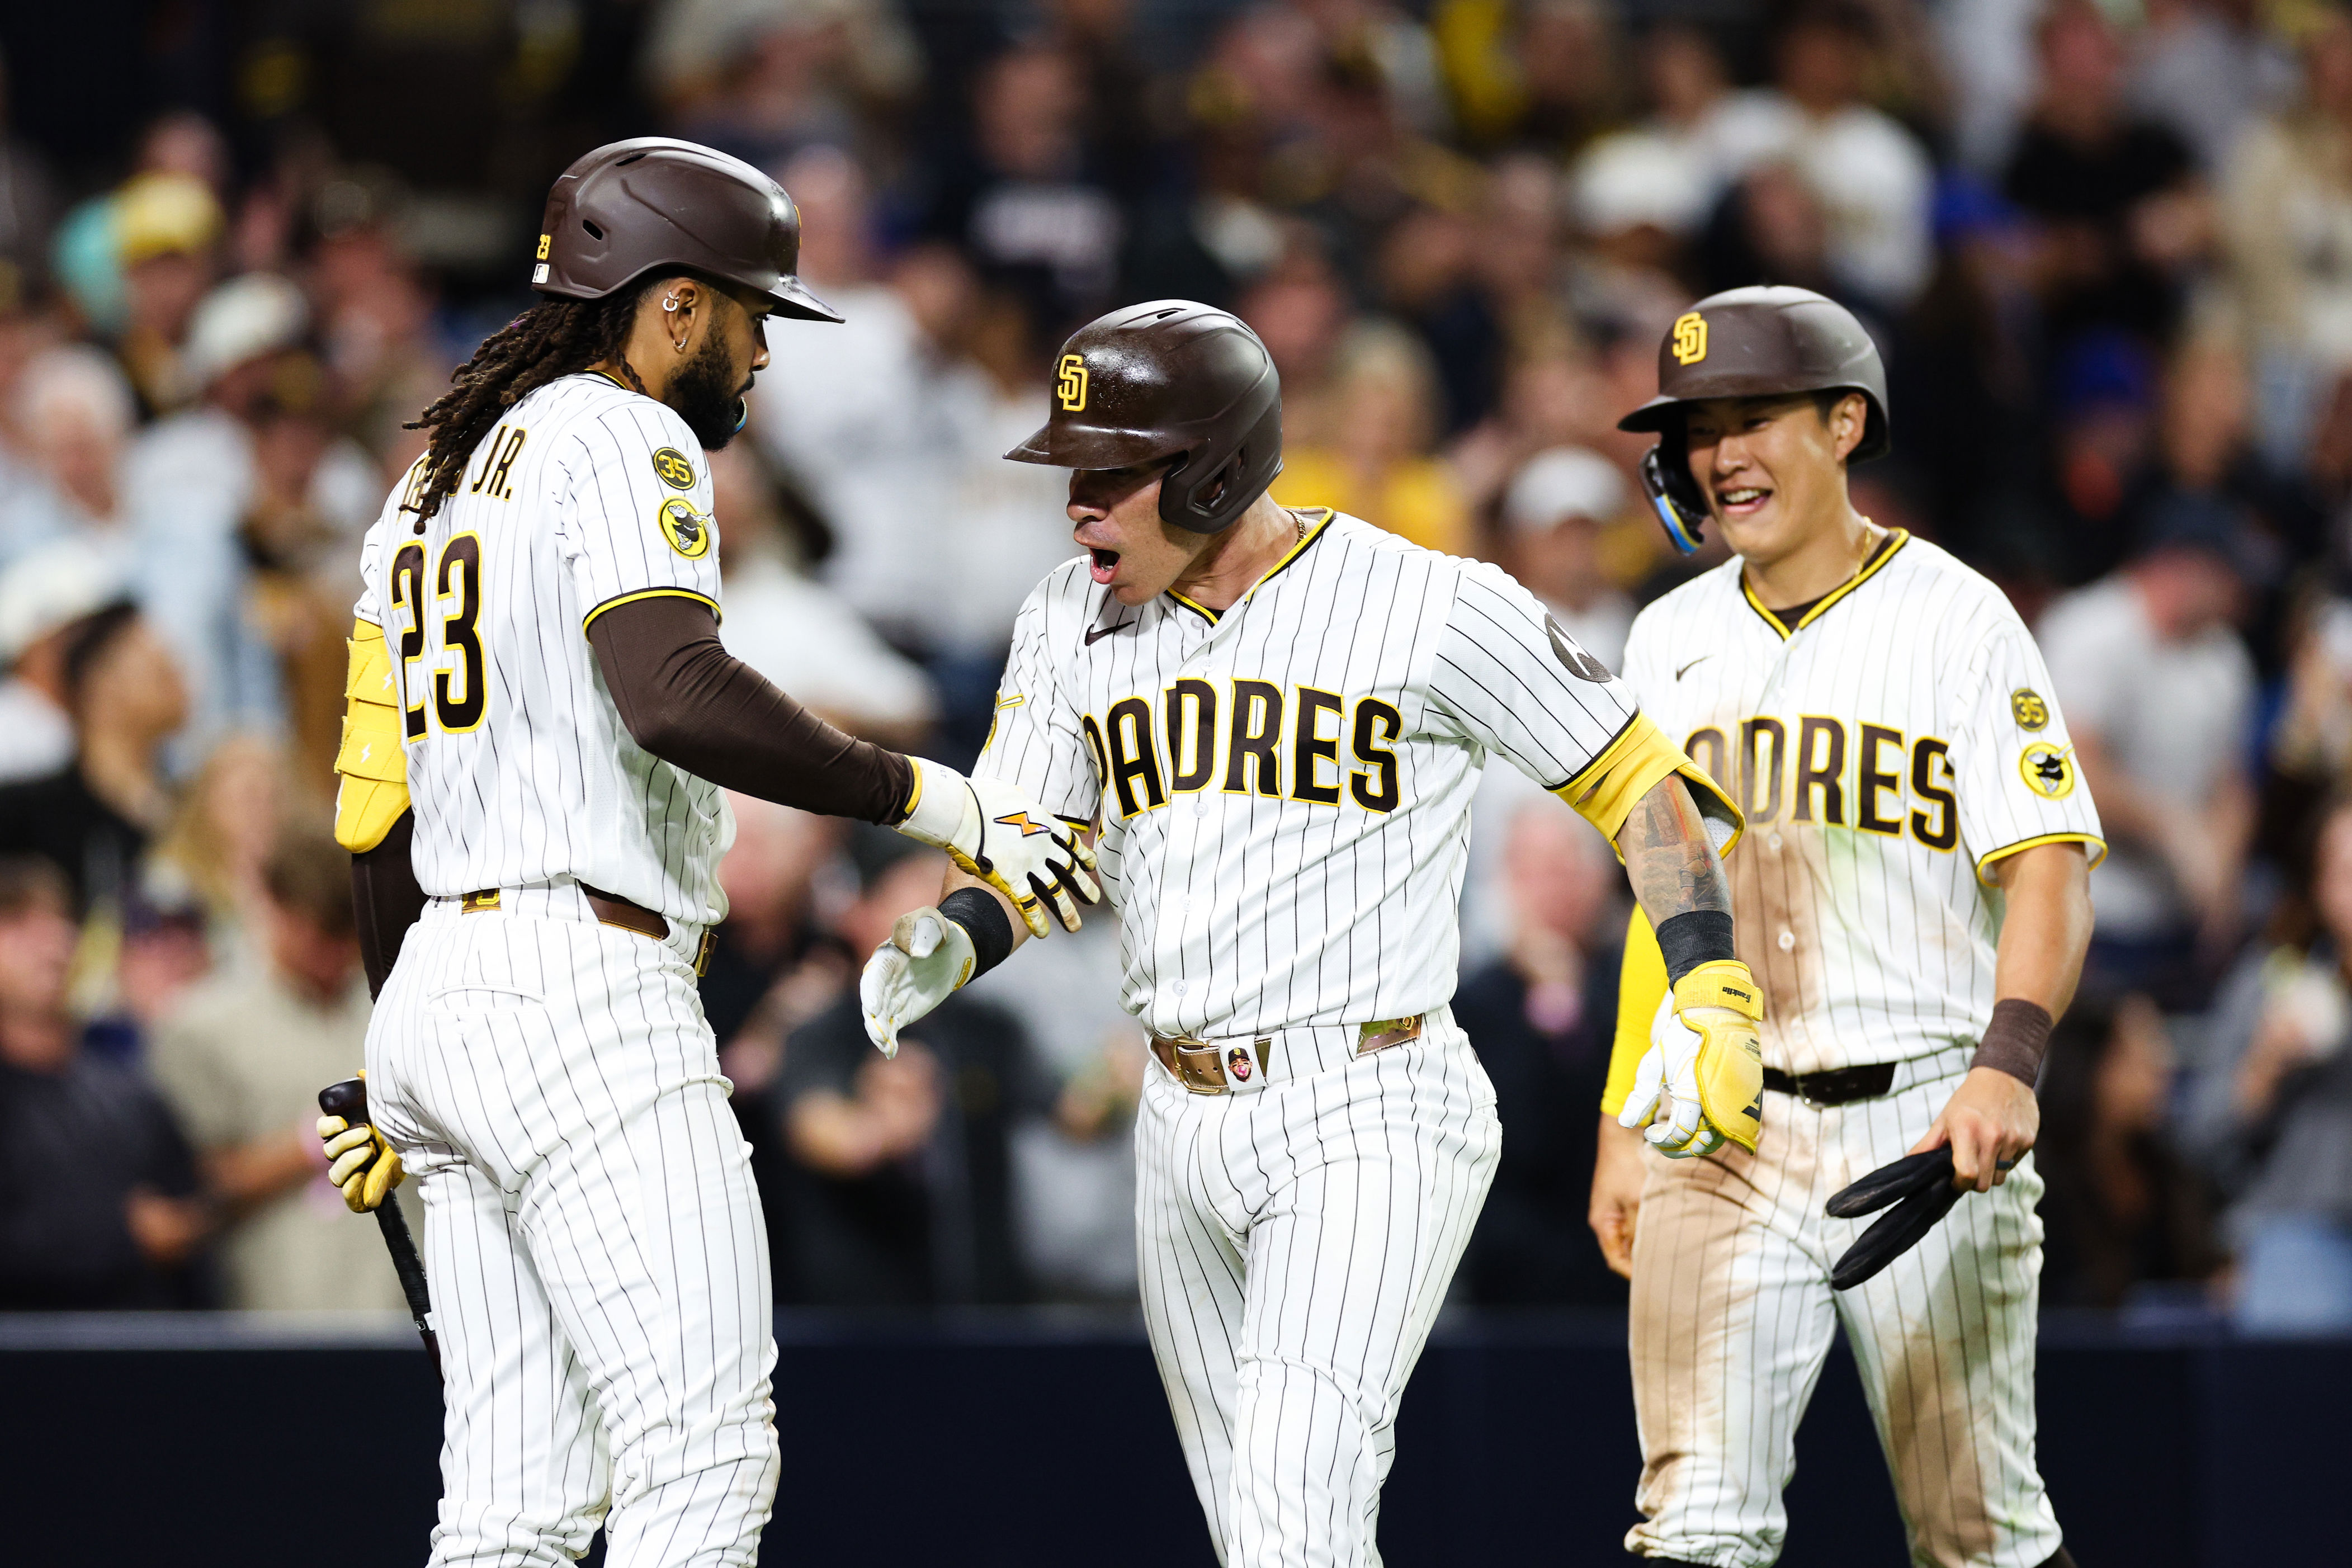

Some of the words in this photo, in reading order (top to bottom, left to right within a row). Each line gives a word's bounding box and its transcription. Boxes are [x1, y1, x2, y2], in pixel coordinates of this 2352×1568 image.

[537, 234, 551, 260] 23
[1673, 311, 1708, 366] SD
[1057, 354, 1088, 412] SD
[470, 424, 527, 502] JR.
[658, 454, 691, 483] 35
[391, 530, 488, 744] 23
[2016, 696, 2045, 724] 35
